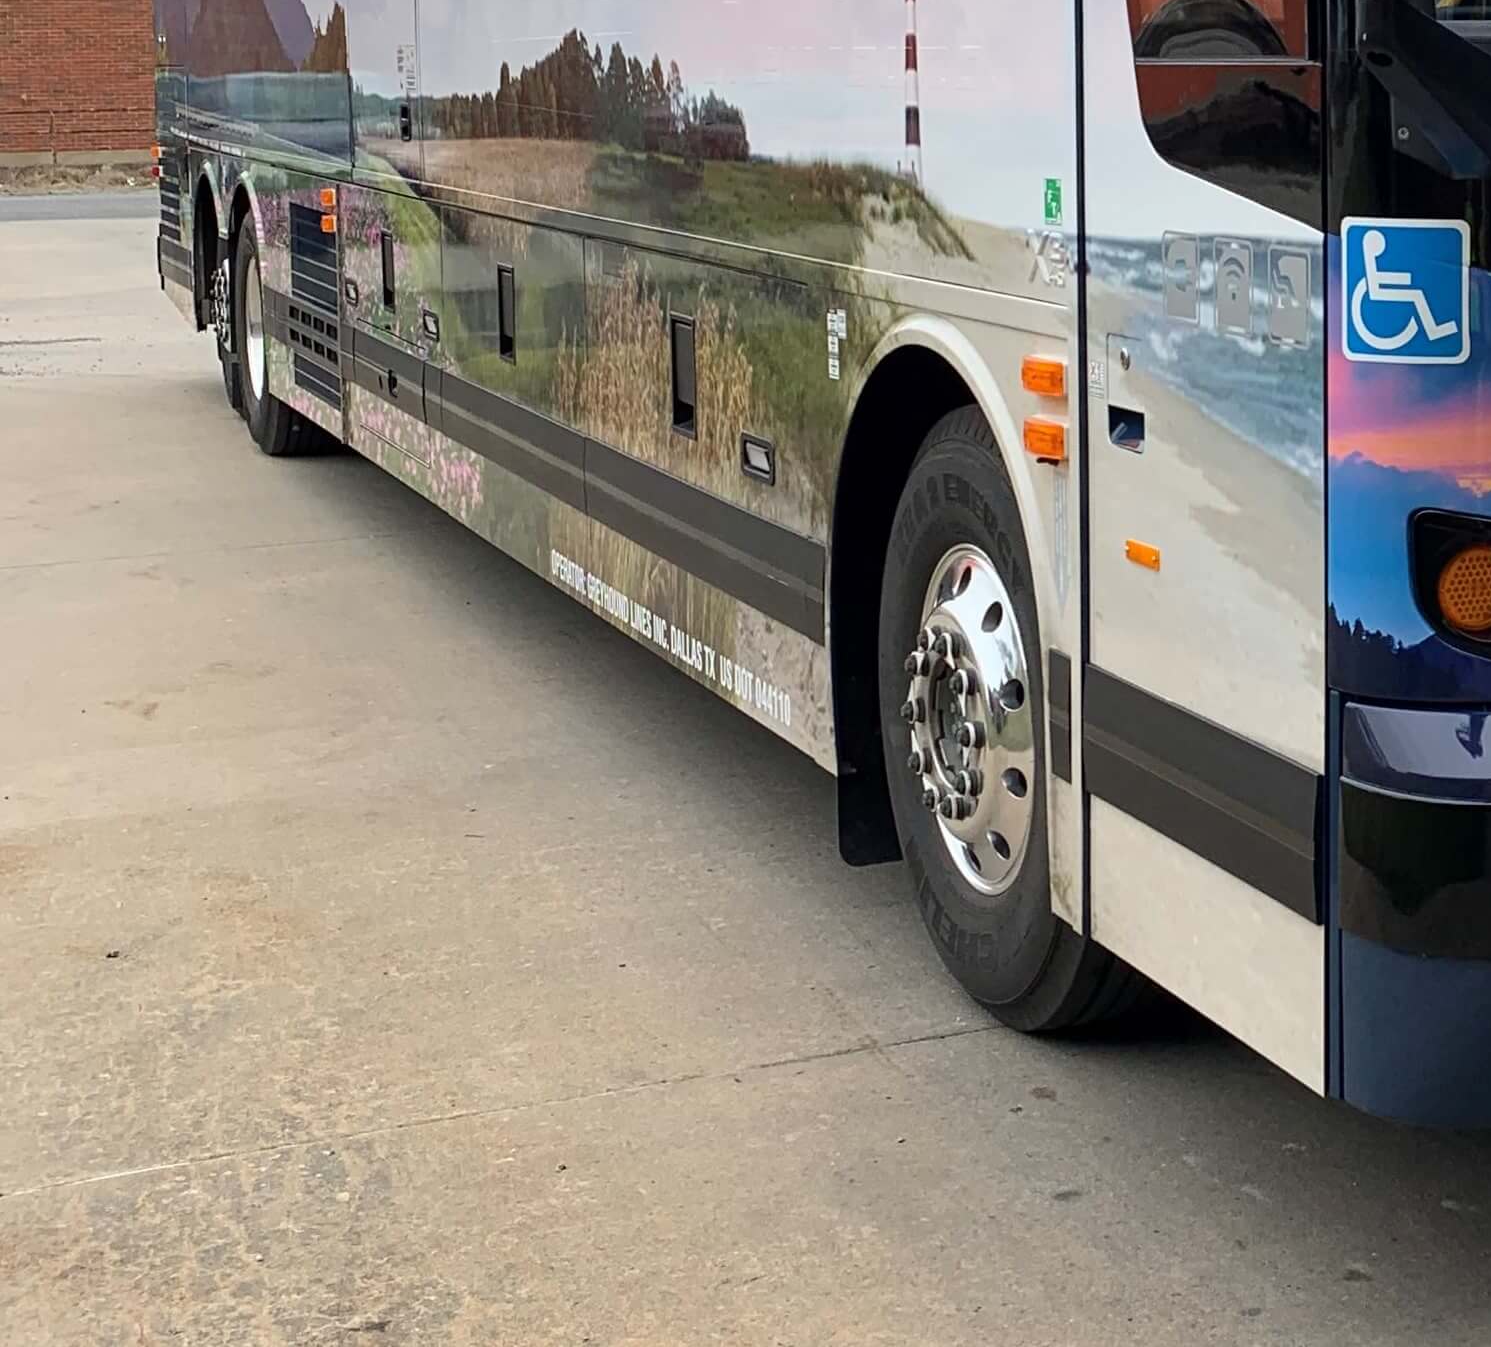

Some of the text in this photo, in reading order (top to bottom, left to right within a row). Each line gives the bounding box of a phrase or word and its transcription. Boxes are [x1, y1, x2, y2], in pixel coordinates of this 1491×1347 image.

[587, 571, 629, 624] GREYHOUND
[630, 598, 652, 640] LINES
[653, 613, 670, 651] INC.
[671, 624, 703, 672] DALLAS
[703, 644, 716, 681] TX
[720, 654, 733, 691] US
[734, 663, 754, 703] DOT
